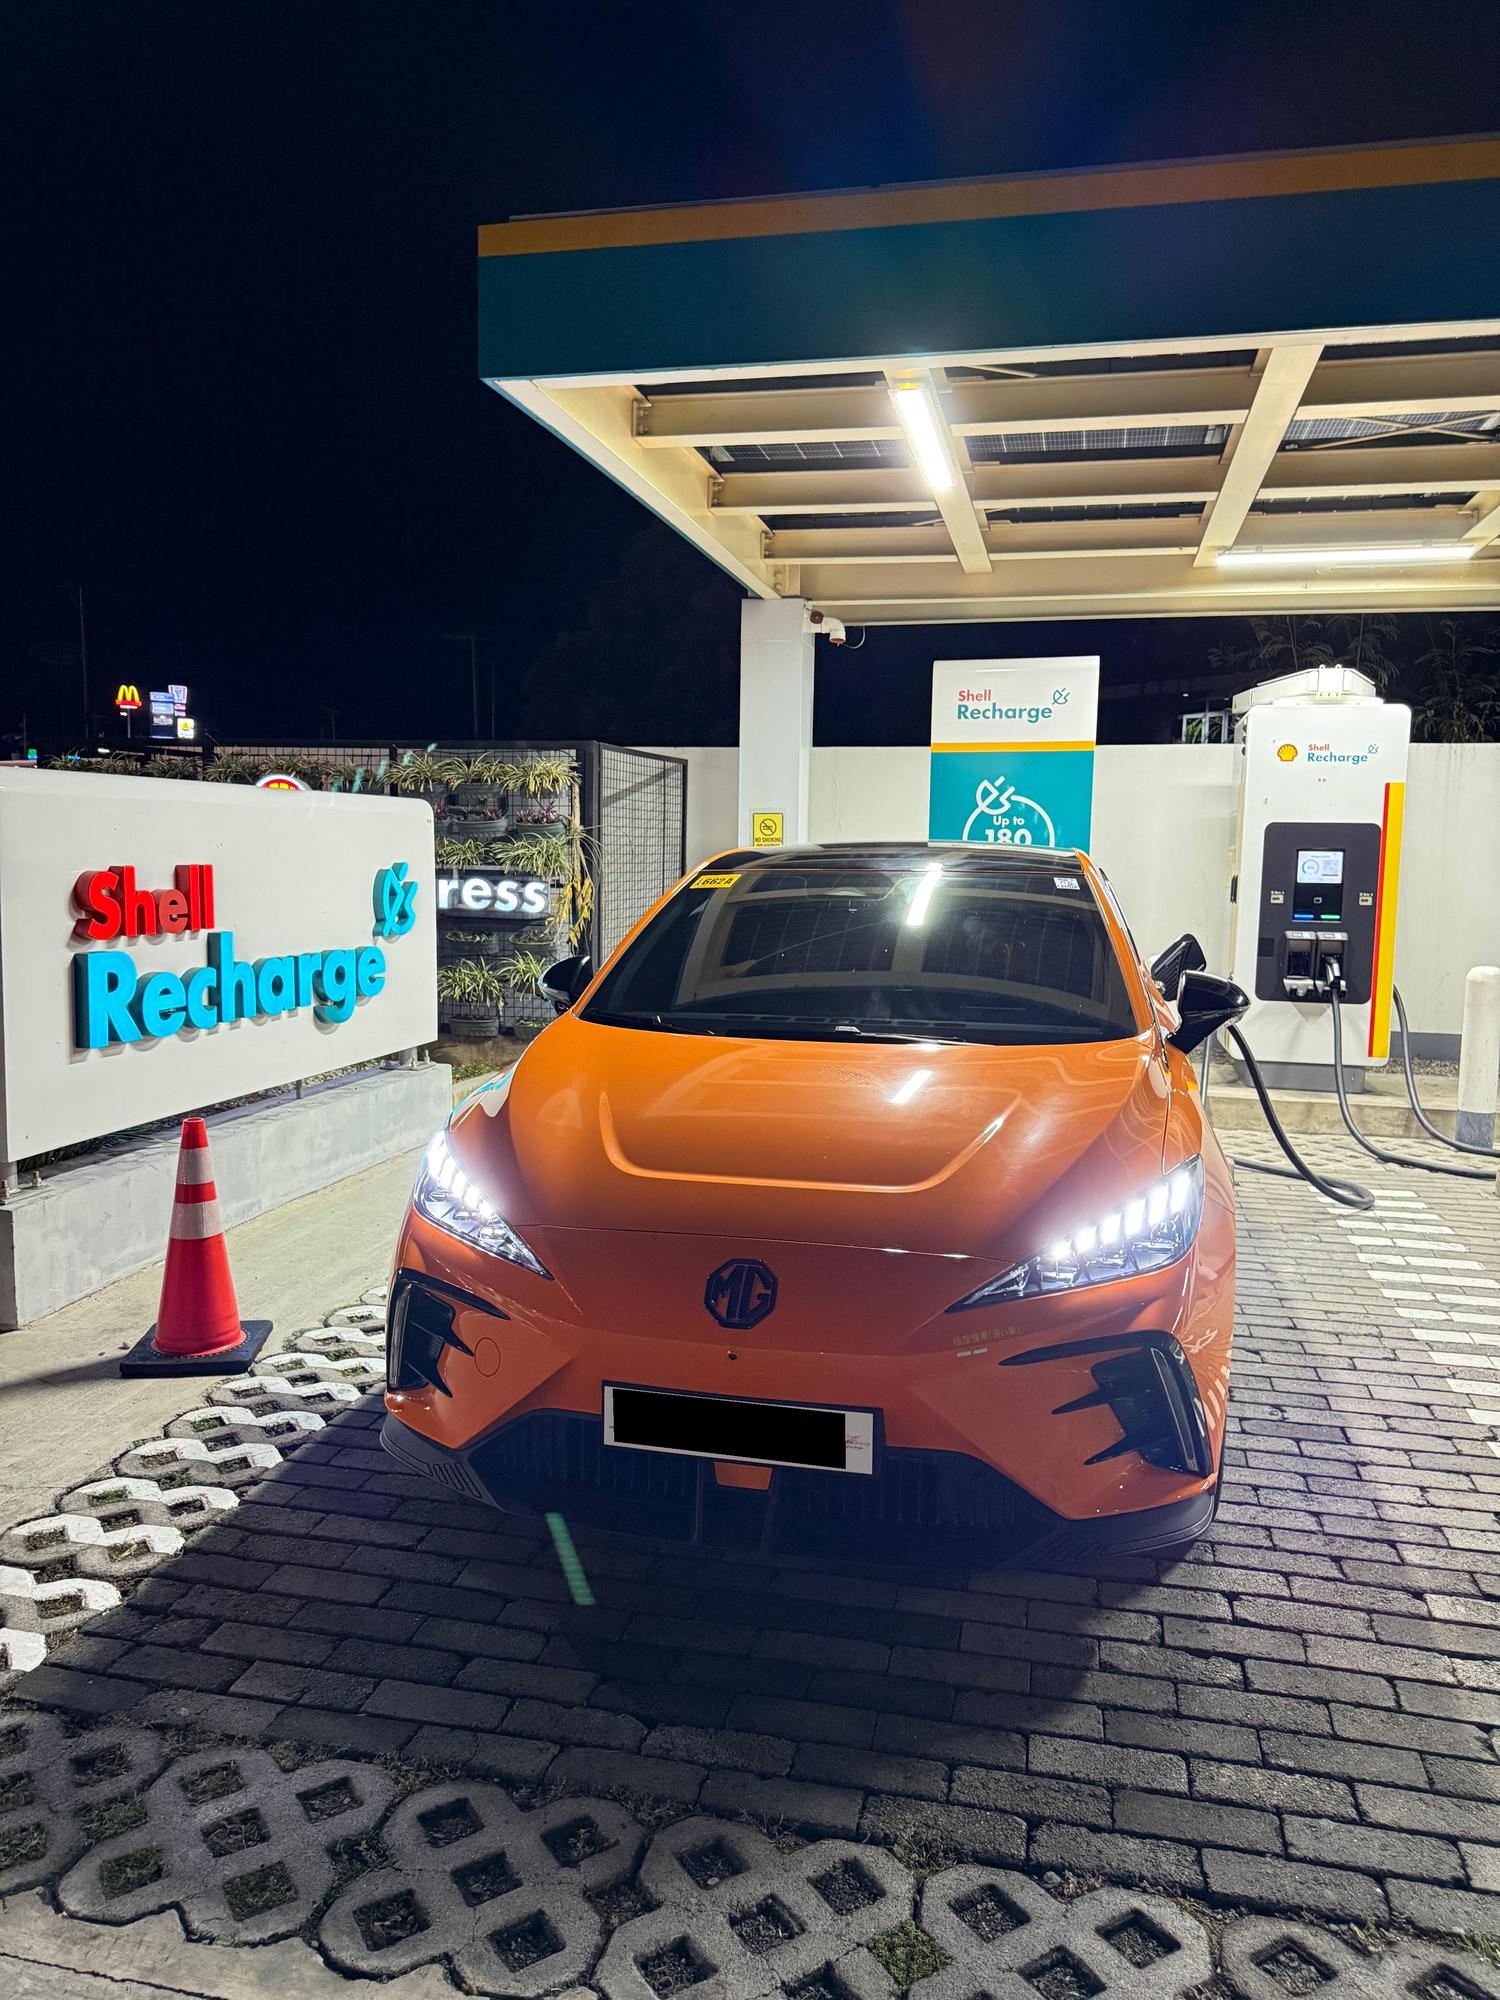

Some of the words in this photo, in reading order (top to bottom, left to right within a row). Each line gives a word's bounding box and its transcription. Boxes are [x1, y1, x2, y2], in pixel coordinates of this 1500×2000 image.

[958, 689, 992, 702] Shell
[957, 702, 1053, 724] Recharge
[1308, 743, 1330, 751] Shell
[1307, 752, 1368, 765] Recharge
[993, 815, 1010, 828] Up
[1012, 815, 1025, 826] to
[985, 828, 1032, 845] 180
[74, 864, 215, 940] Shell
[75, 931, 386, 1049] Recharge
[710, 1262, 773, 1325] MG
